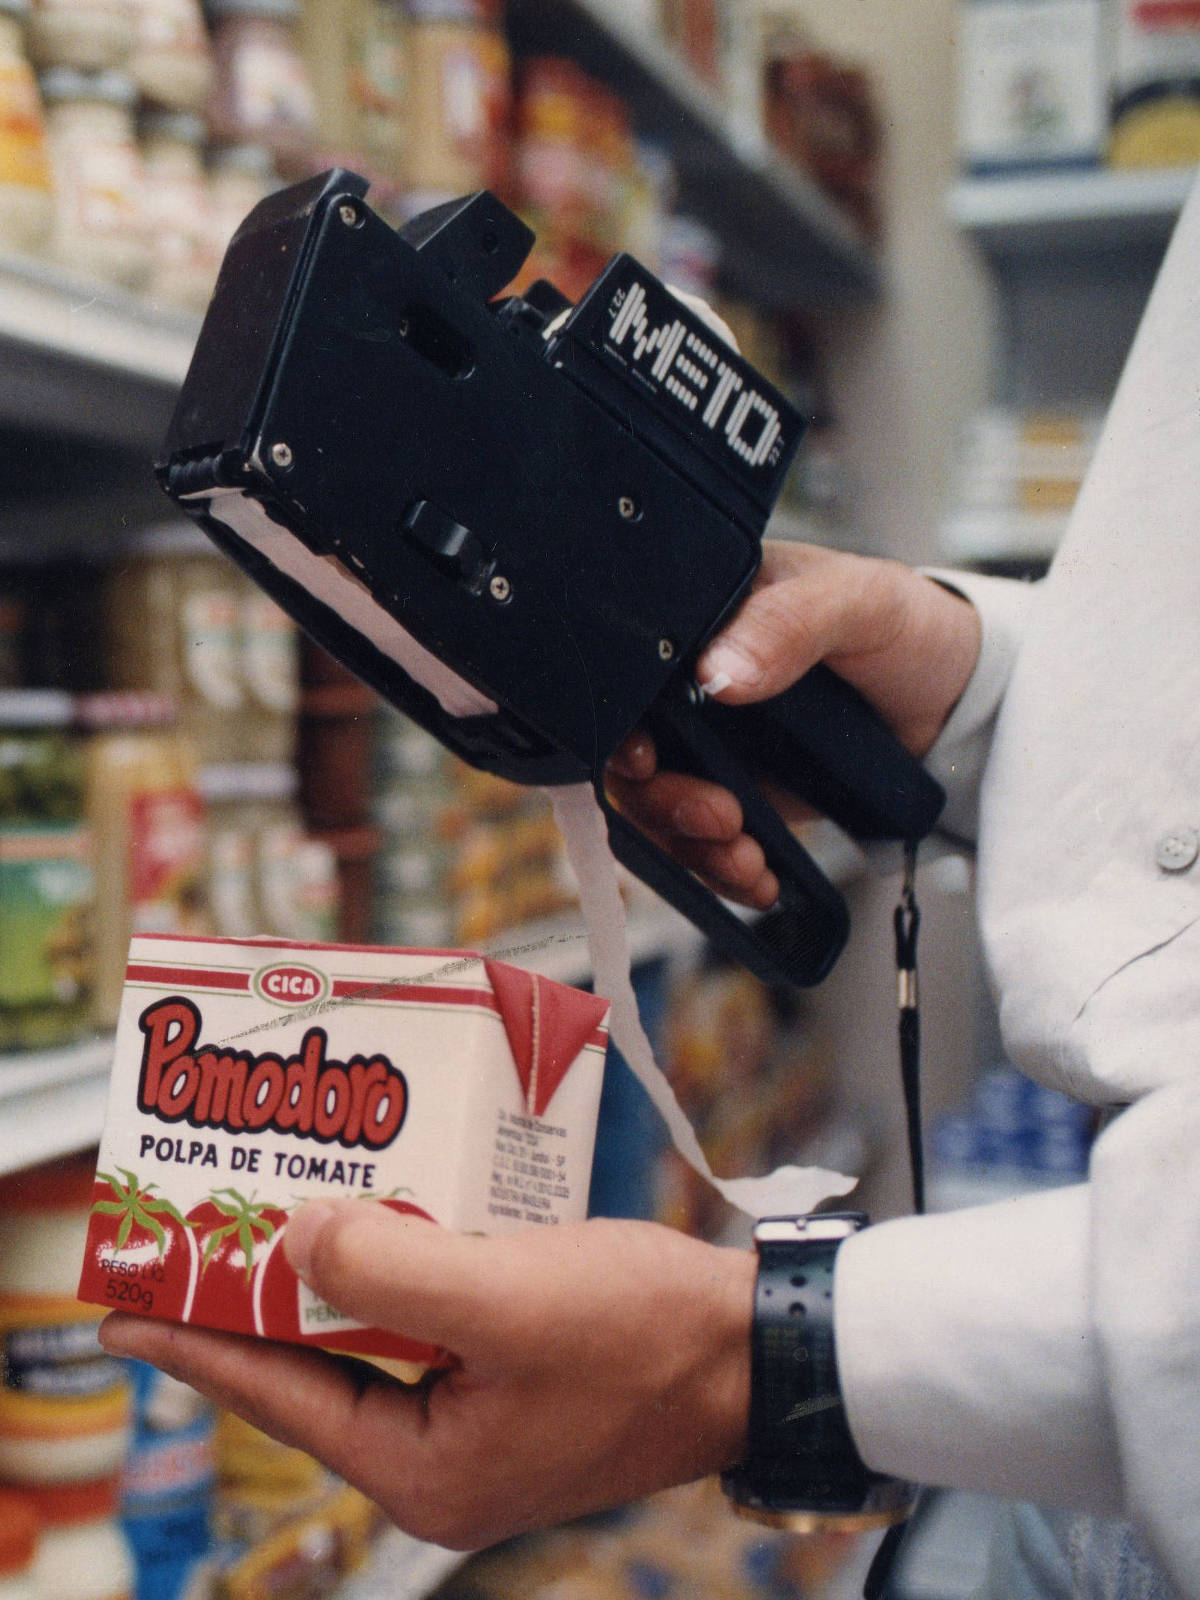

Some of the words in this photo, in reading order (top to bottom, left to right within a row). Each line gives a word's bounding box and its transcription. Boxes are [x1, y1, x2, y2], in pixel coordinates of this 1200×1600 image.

[609, 282, 781, 466] METO
[267, 974, 315, 995] CICA
[137, 995, 409, 1152] Pomodoro
[140, 1134, 218, 1168] POLPA
[230, 1147, 262, 1173] DE
[274, 1152, 377, 1188] TOMATE
[101, 1258, 139, 1279] PESO
[104, 1279, 154, 1312] 520g
